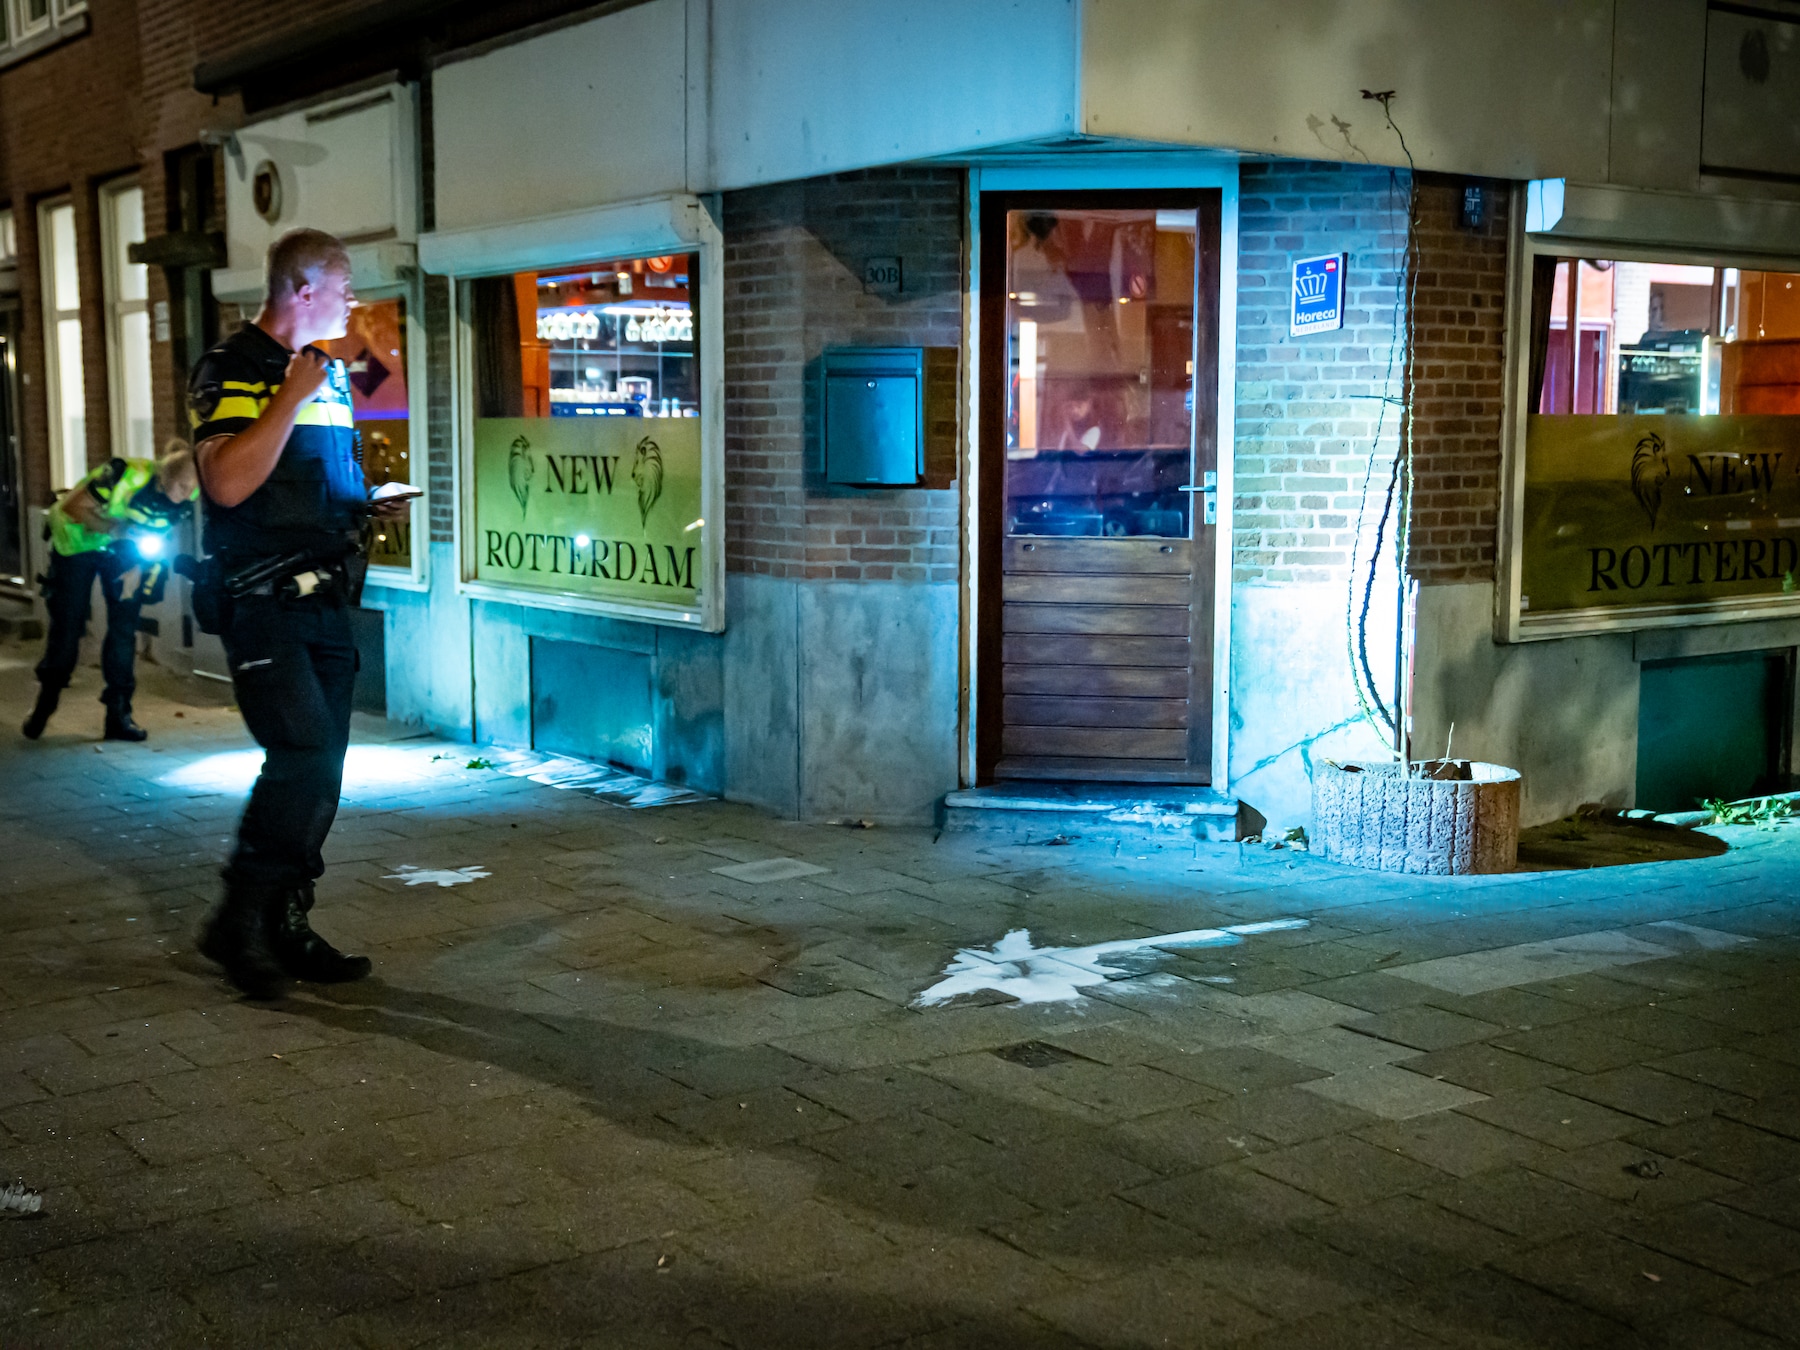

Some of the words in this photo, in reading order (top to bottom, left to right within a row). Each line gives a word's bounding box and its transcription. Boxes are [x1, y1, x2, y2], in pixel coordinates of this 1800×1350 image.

[866, 267, 898, 283] 30B
[1296, 309, 1335, 324] Horeca
[1296, 321, 1335, 333] NEDERLAND
[545, 455, 620, 495] NEW
[1687, 453, 1783, 494] NEW
[485, 530, 696, 589] ROTTERDAM
[1587, 538, 1800, 592] ROTTERD
